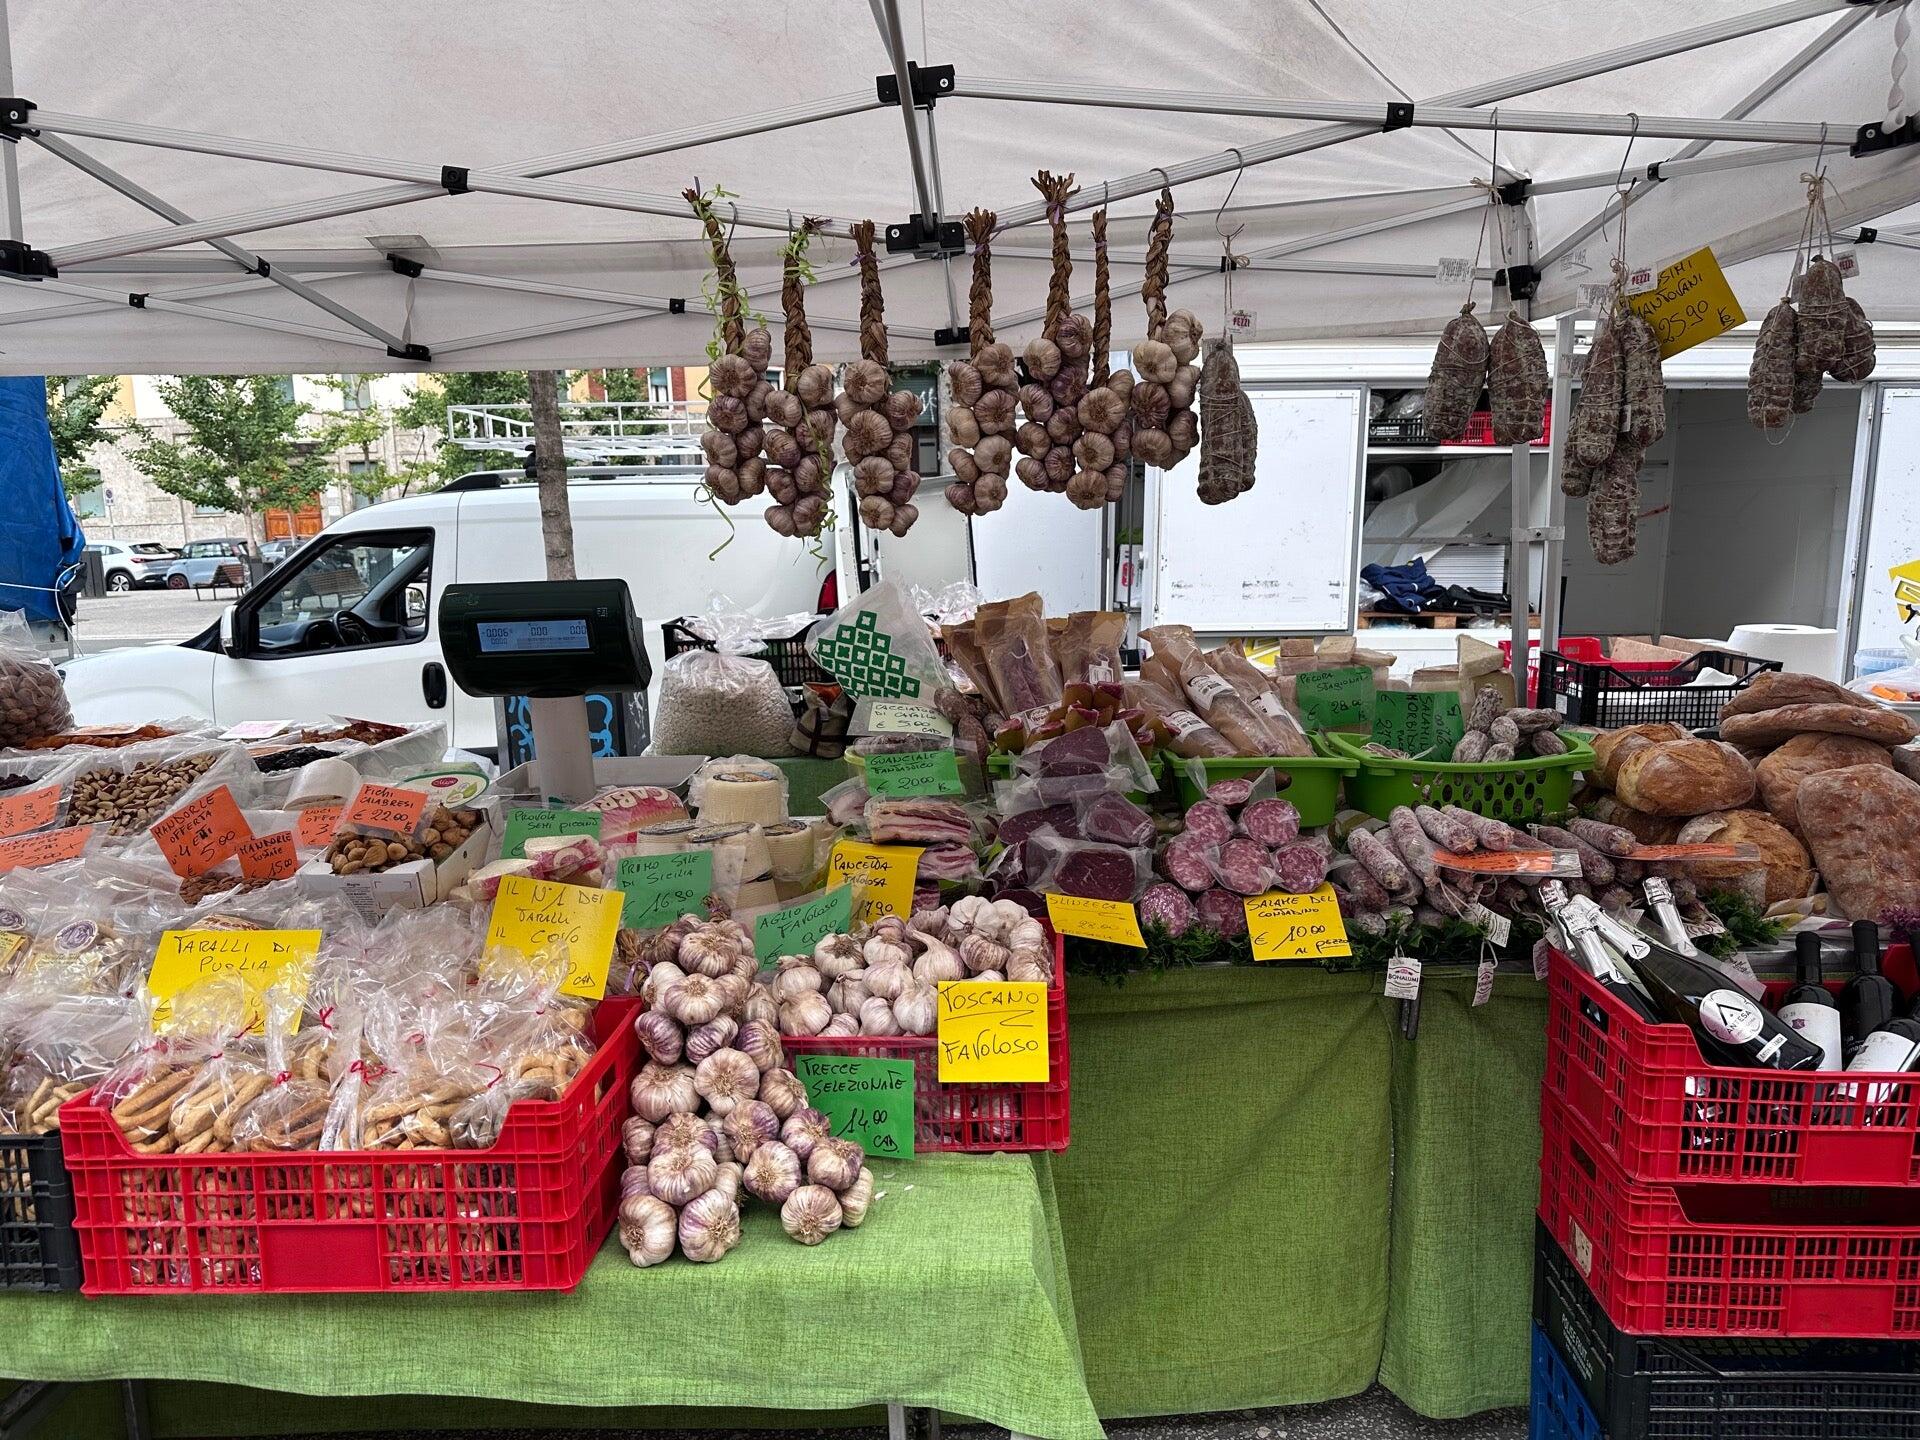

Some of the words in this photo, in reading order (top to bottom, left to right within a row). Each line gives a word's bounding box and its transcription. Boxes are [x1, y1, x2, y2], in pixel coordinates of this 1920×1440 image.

[1631, 273, 1650, 285] PEZZI
[1232, 316, 1250, 328] PEZZI
[154, 793, 215, 839] MANDORLE
[169, 809, 213, 844] OFFERTA
[179, 844, 191, 857] 4
[622, 880, 635, 888] DI
[646, 869, 693, 885] SICILIA
[506, 881, 519, 895] IL
[578, 890, 604, 904] DEI
[1309, 895, 1335, 904] DEL
[759, 908, 802, 930] AGLIO
[777, 898, 838, 939] FAVOLOSO
[173, 932, 249, 954] TARALLI
[273, 941, 291, 953] DI
[495, 926, 506, 938] IL
[1254, 931, 1269, 945] €
[940, 983, 1039, 1012] TOSCANO
[1726, 1010, 1752, 1034] ANTESA
[941, 1028, 1039, 1065] FAVOLOSO
[801, 1057, 862, 1076] TRECCE
[812, 1070, 907, 1098] SELEZIONATE
